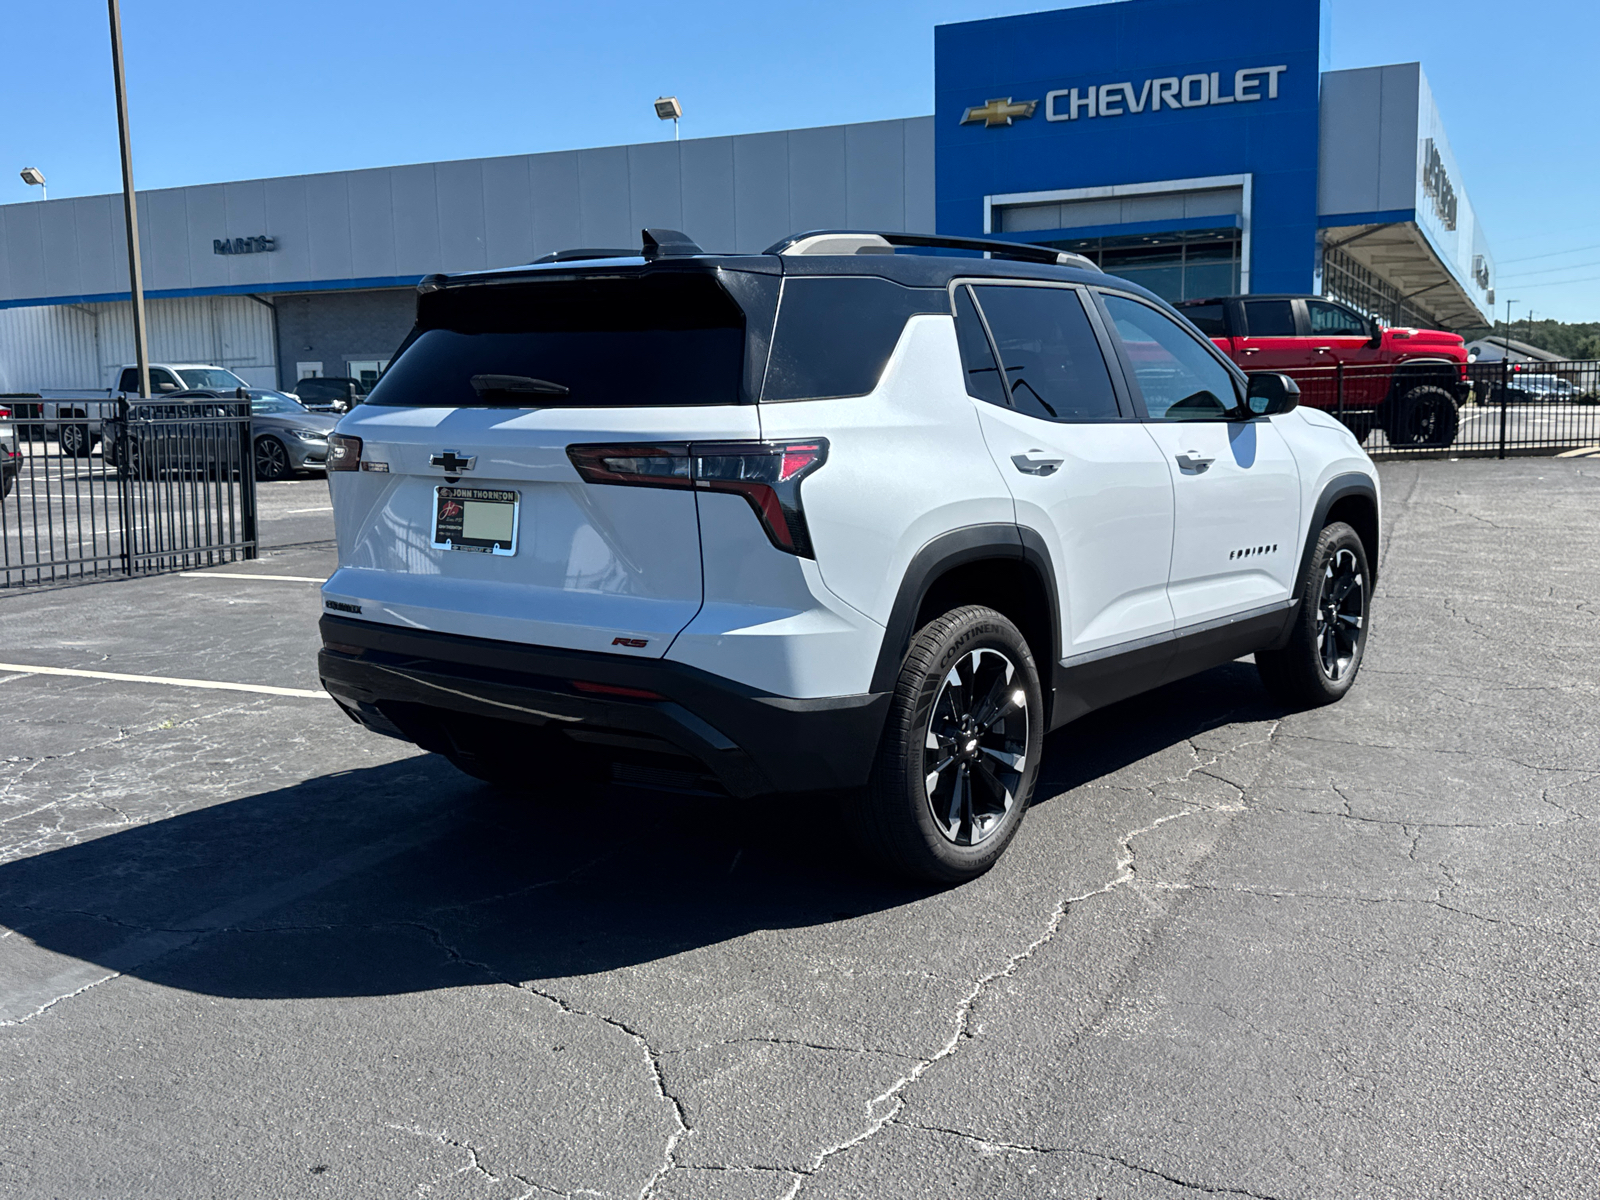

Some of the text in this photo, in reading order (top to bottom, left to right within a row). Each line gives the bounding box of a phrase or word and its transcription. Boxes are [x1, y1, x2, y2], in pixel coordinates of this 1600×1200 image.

[1045, 65, 1287, 122] CHEVROLET
[213, 235, 275, 255] PARTS
[453, 489, 473, 498] JOHN
[611, 637, 649, 648] RS
